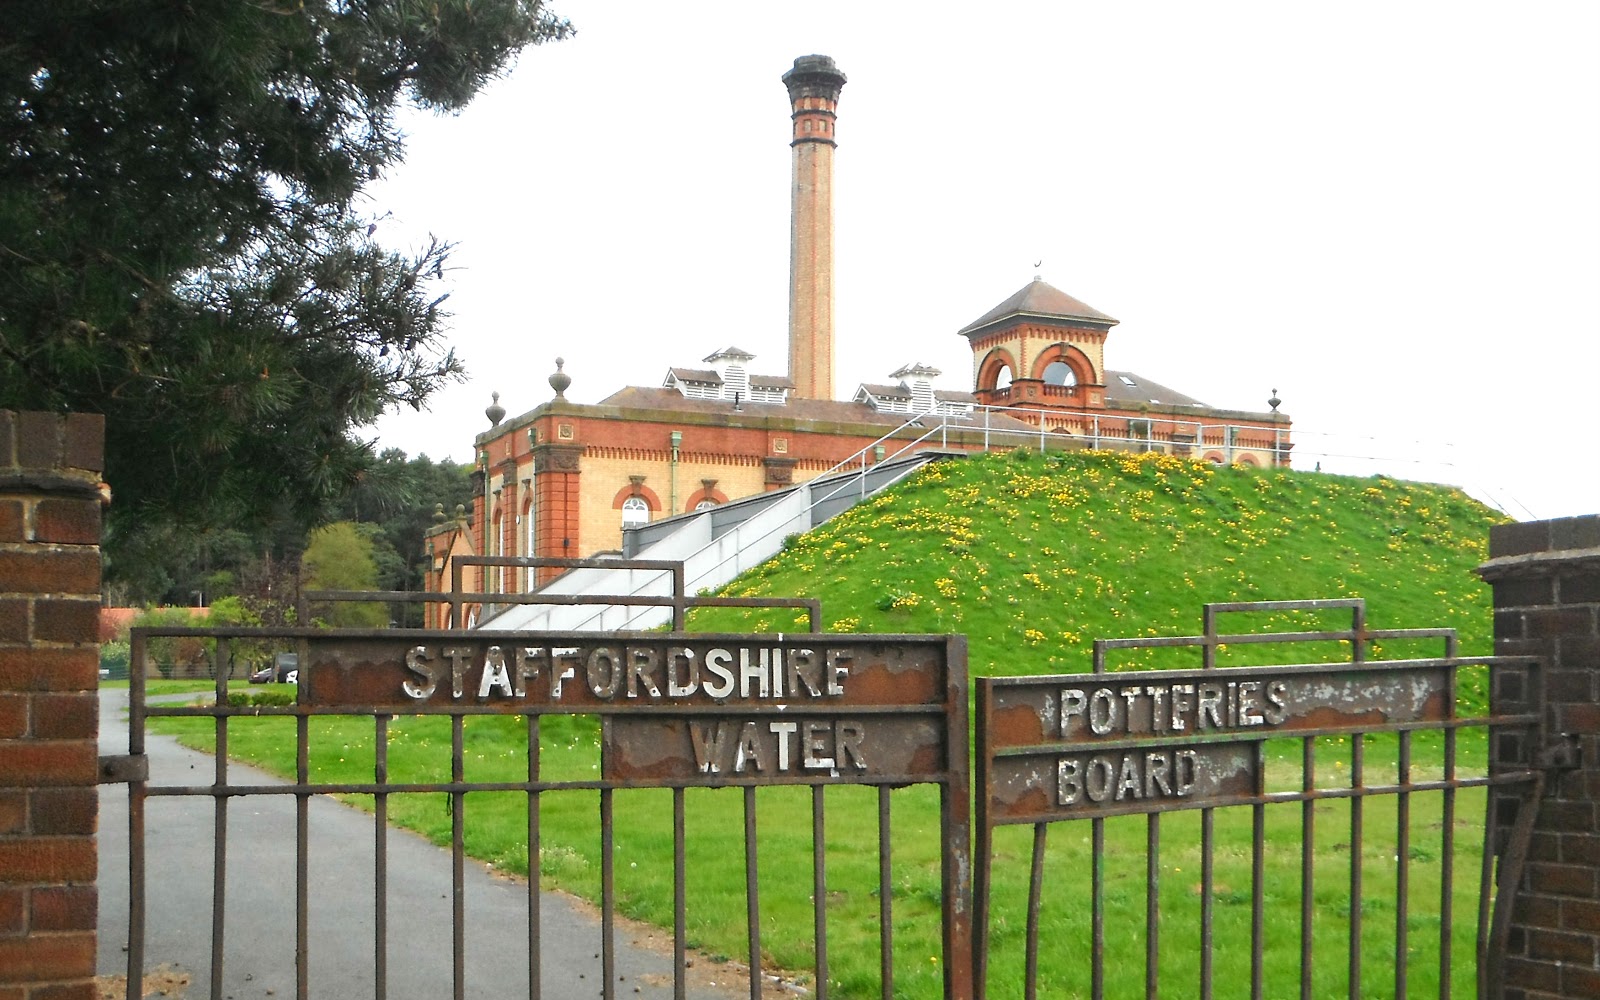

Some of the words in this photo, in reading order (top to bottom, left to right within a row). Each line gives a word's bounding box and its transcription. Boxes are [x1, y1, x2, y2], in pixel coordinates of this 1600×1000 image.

[402, 644, 852, 699] STAFFORDSHIRE
[1059, 681, 1287, 738] POTTERIES
[688, 721, 868, 773] WATER
[1057, 749, 1201, 806] BOARD
